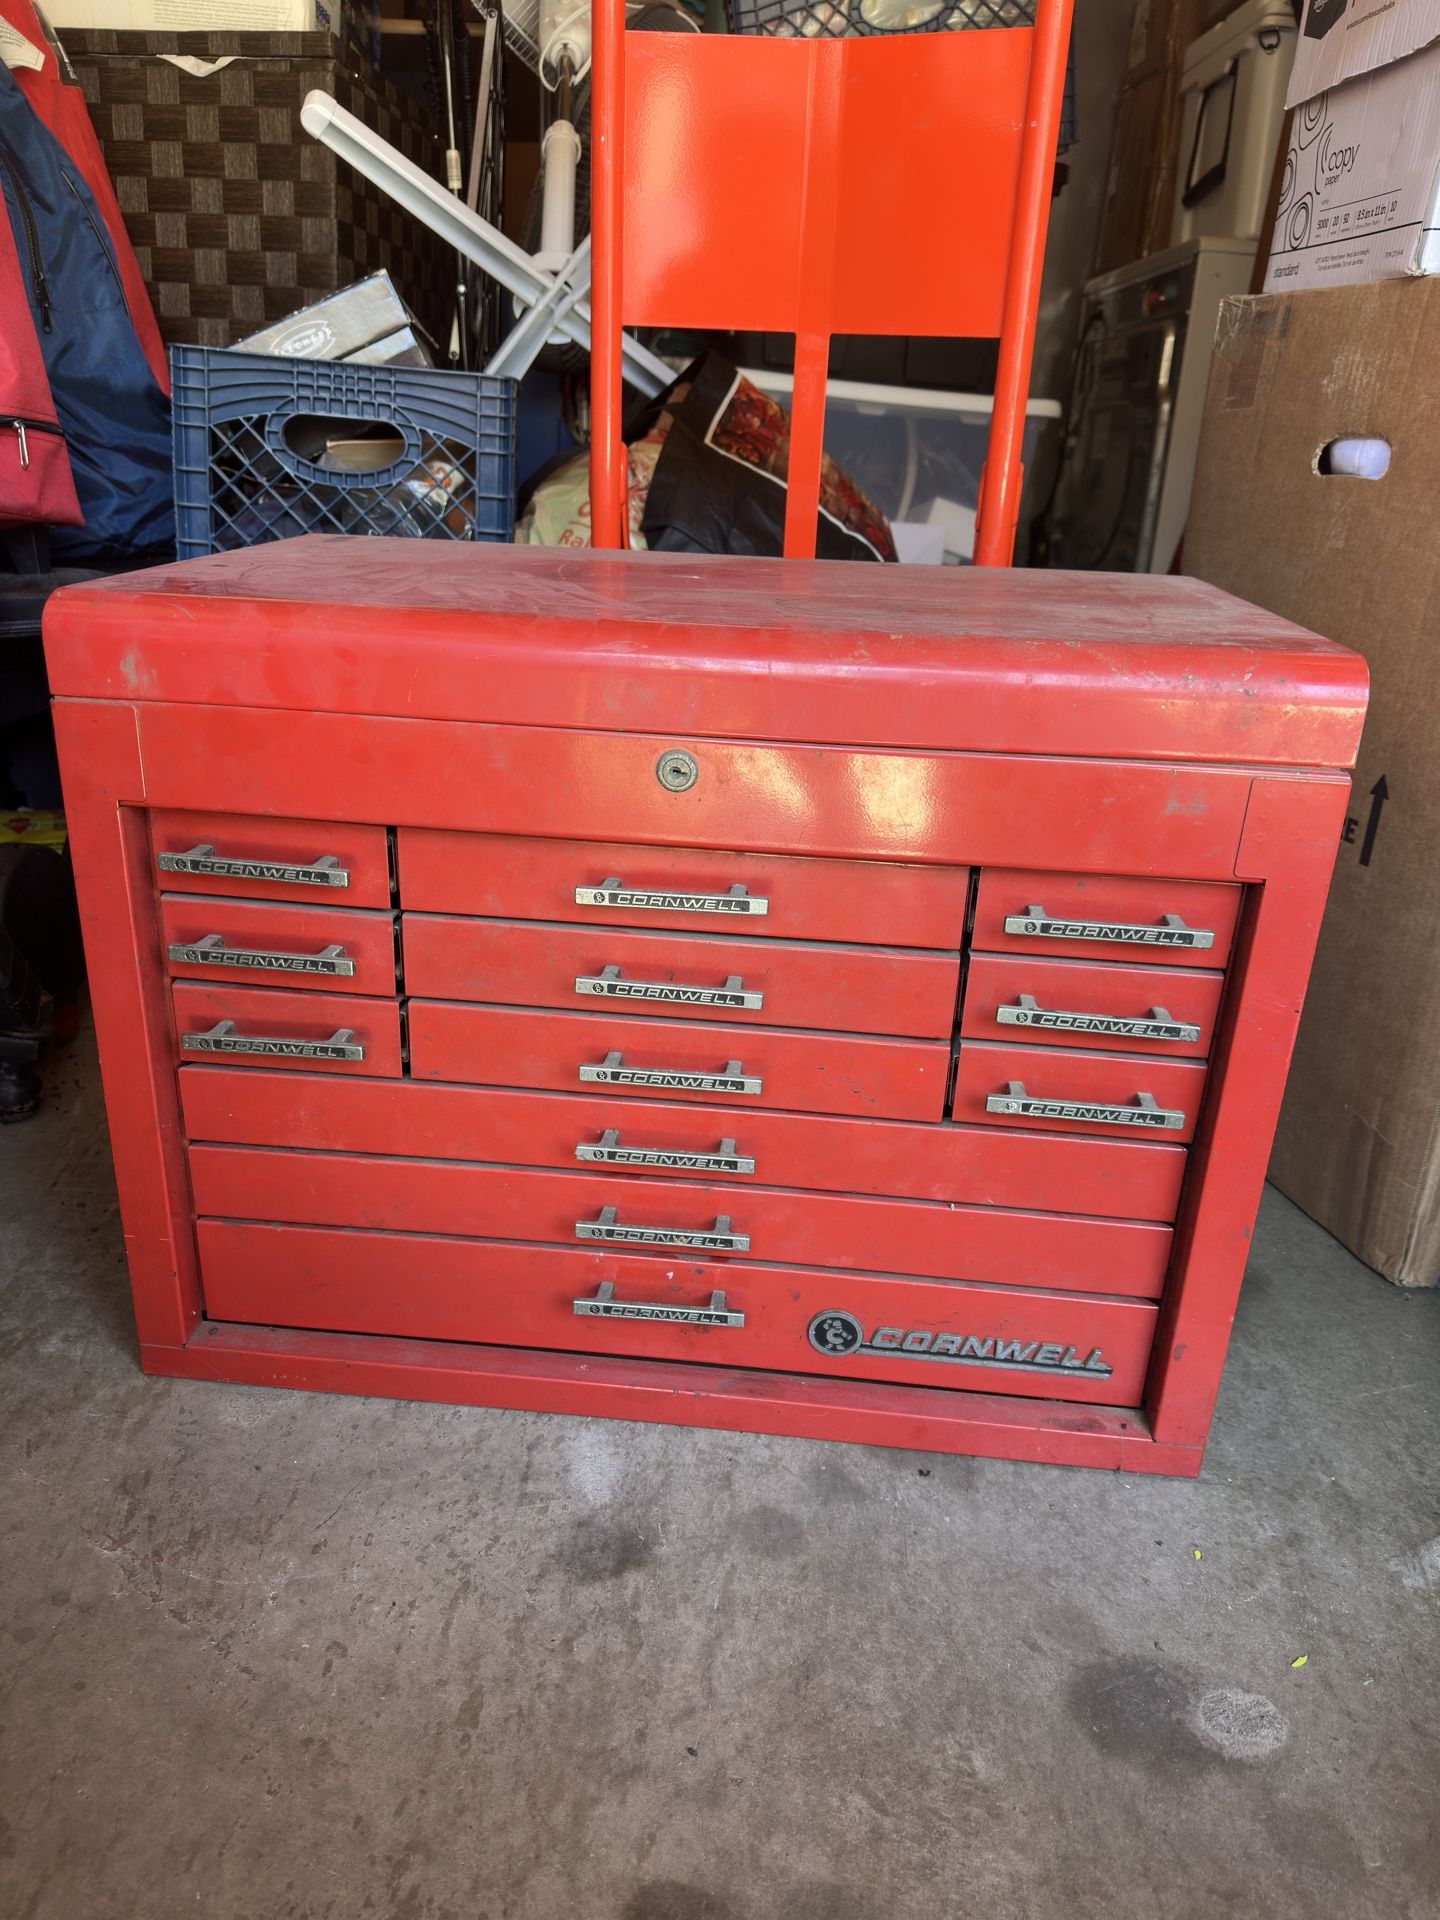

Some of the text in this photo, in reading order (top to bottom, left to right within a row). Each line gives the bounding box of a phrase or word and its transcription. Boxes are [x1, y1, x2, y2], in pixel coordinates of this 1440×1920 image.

[1328, 144, 1360, 174] copy
[1324, 174, 1340, 188] paper
[1273, 263, 1299, 279] standard
[198, 862, 321, 882] CORNWELL
[617, 894, 741, 911] CORNWELL
[1049, 924, 1185, 944] CORNWELL
[208, 953, 328, 971] CORNWELL
[615, 985, 736, 1005] CORNWELL
[1039, 1015, 1172, 1037] CORNWELL
[220, 1041, 337, 1057] CORNWELL
[618, 1073, 738, 1090] CORNWELL
[1028, 1104, 1157, 1124] CORNWELL
[615, 1152, 730, 1169] CORNWELL
[613, 1230, 727, 1247] CORNWELL
[610, 1307, 721, 1323] CORNWELL
[870, 1326, 1111, 1371] CORNWELL
